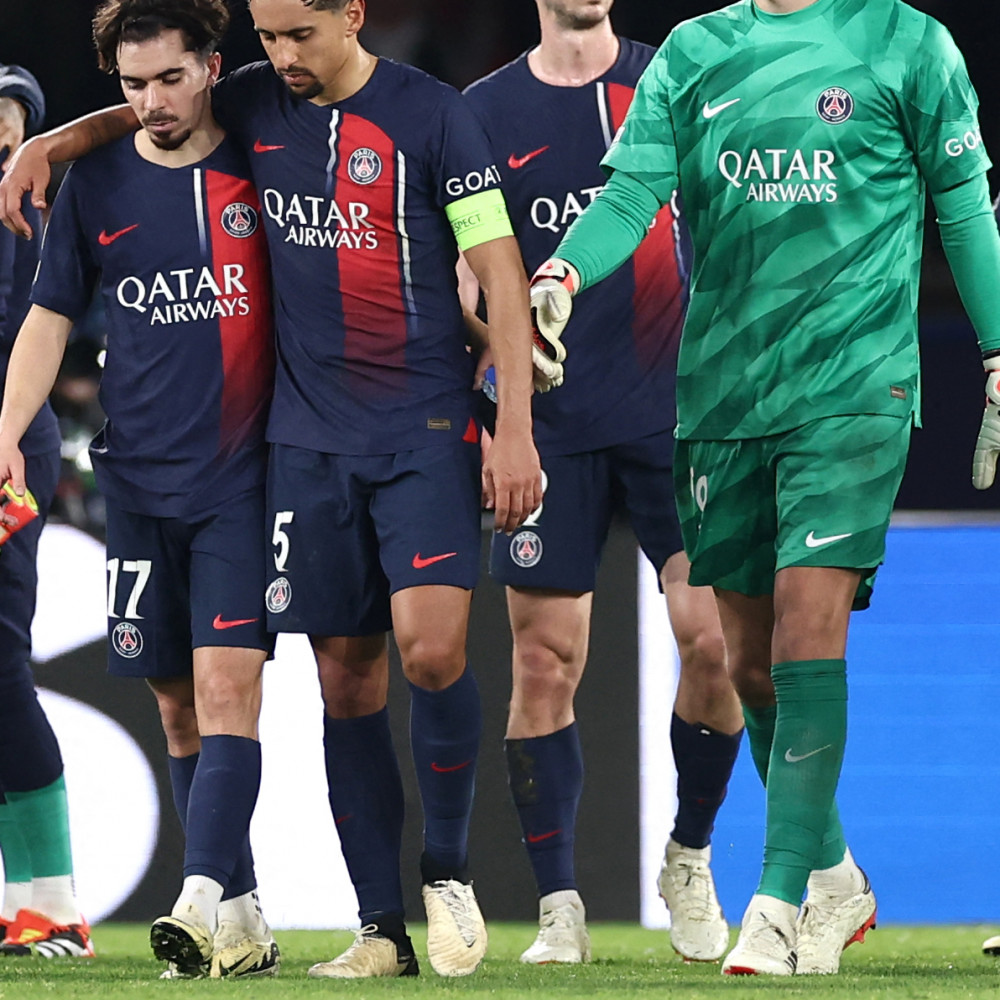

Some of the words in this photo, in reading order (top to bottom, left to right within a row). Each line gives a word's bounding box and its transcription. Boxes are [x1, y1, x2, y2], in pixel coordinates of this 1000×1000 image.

[718, 148, 838, 188] QATAR
[264, 188, 375, 230] QATAR
[746, 182, 838, 203] AIRWAYS
[284, 224, 378, 249] AIRWAYS
[117, 263, 249, 313] QATAR
[150, 296, 250, 326] AIRWAYS
[272, 511, 294, 572] 5
[106, 558, 152, 619] 17
